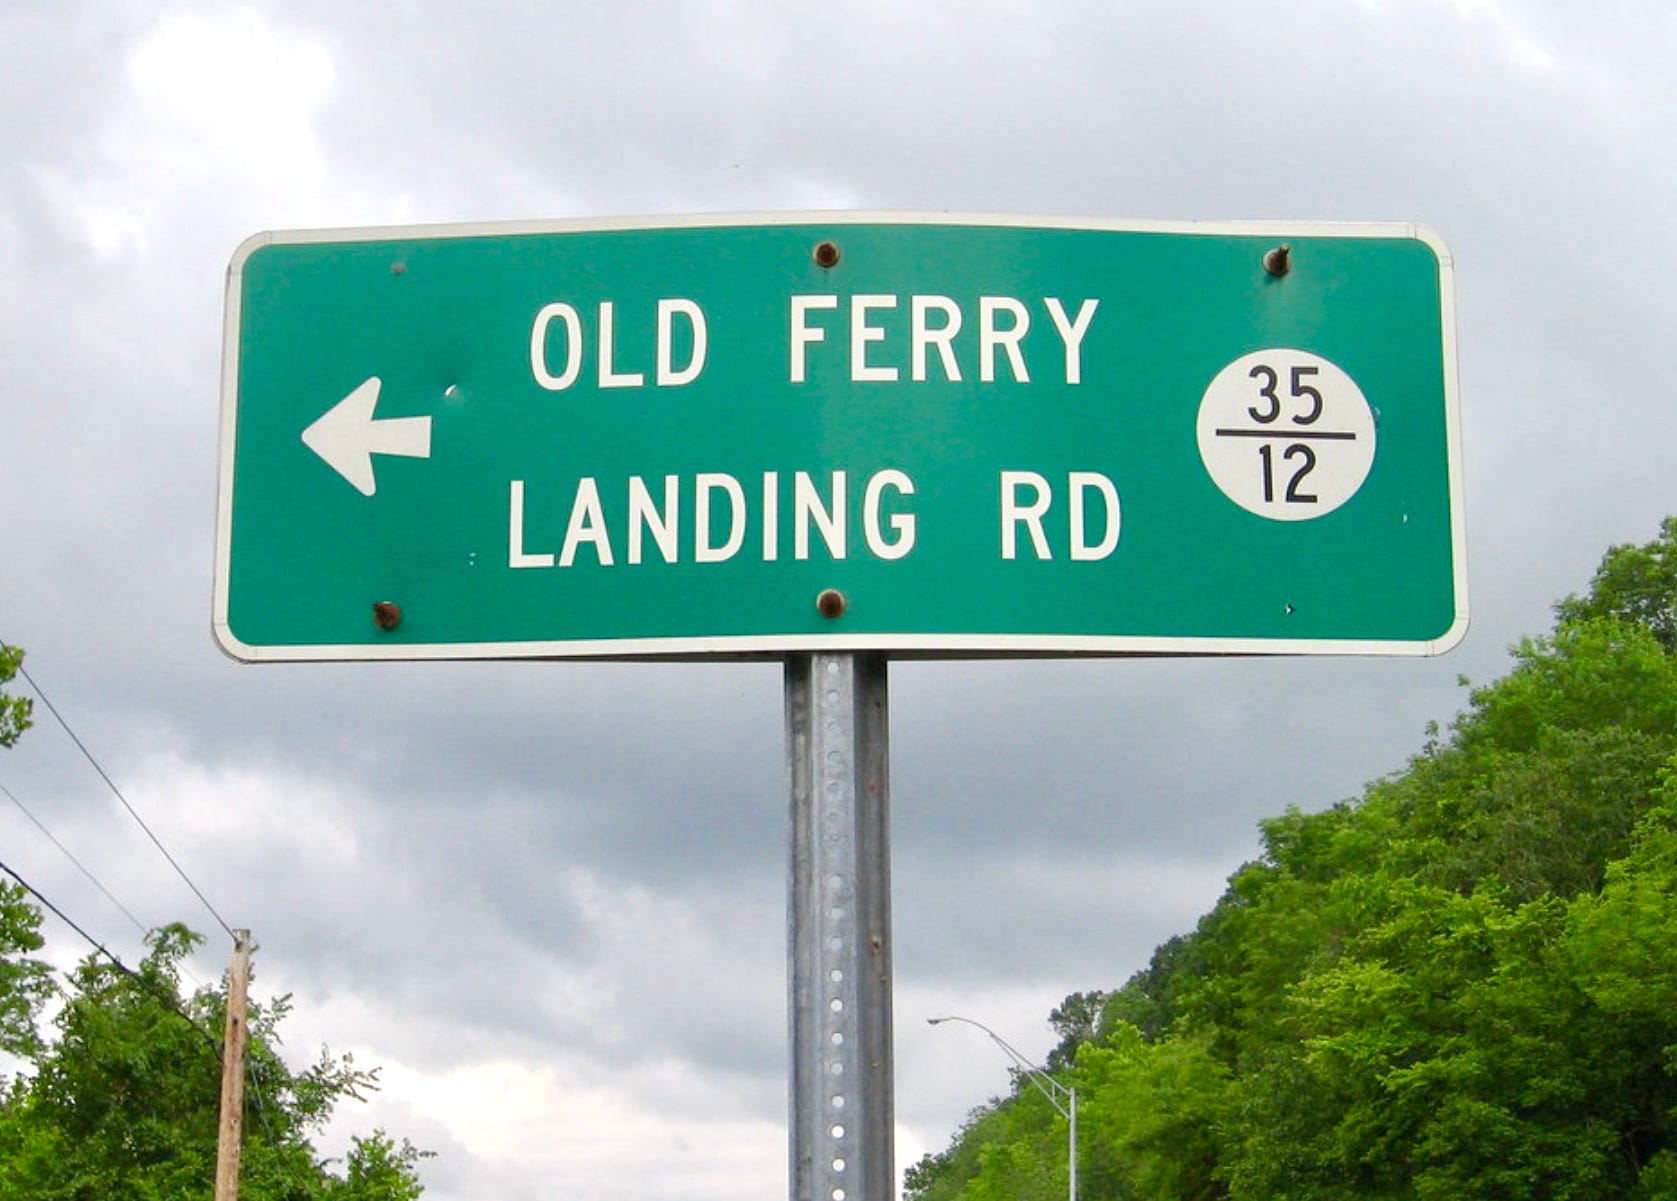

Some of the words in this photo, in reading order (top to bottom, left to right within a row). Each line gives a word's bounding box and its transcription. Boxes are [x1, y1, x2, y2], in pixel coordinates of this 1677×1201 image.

[530, 298, 708, 391] OLD
[789, 294, 1099, 384] FERRY
[1248, 365, 1323, 425] 35
[1259, 443, 1318, 504] 12
[508, 469, 917, 569] LANDING
[1000, 470, 1121, 562] RD
